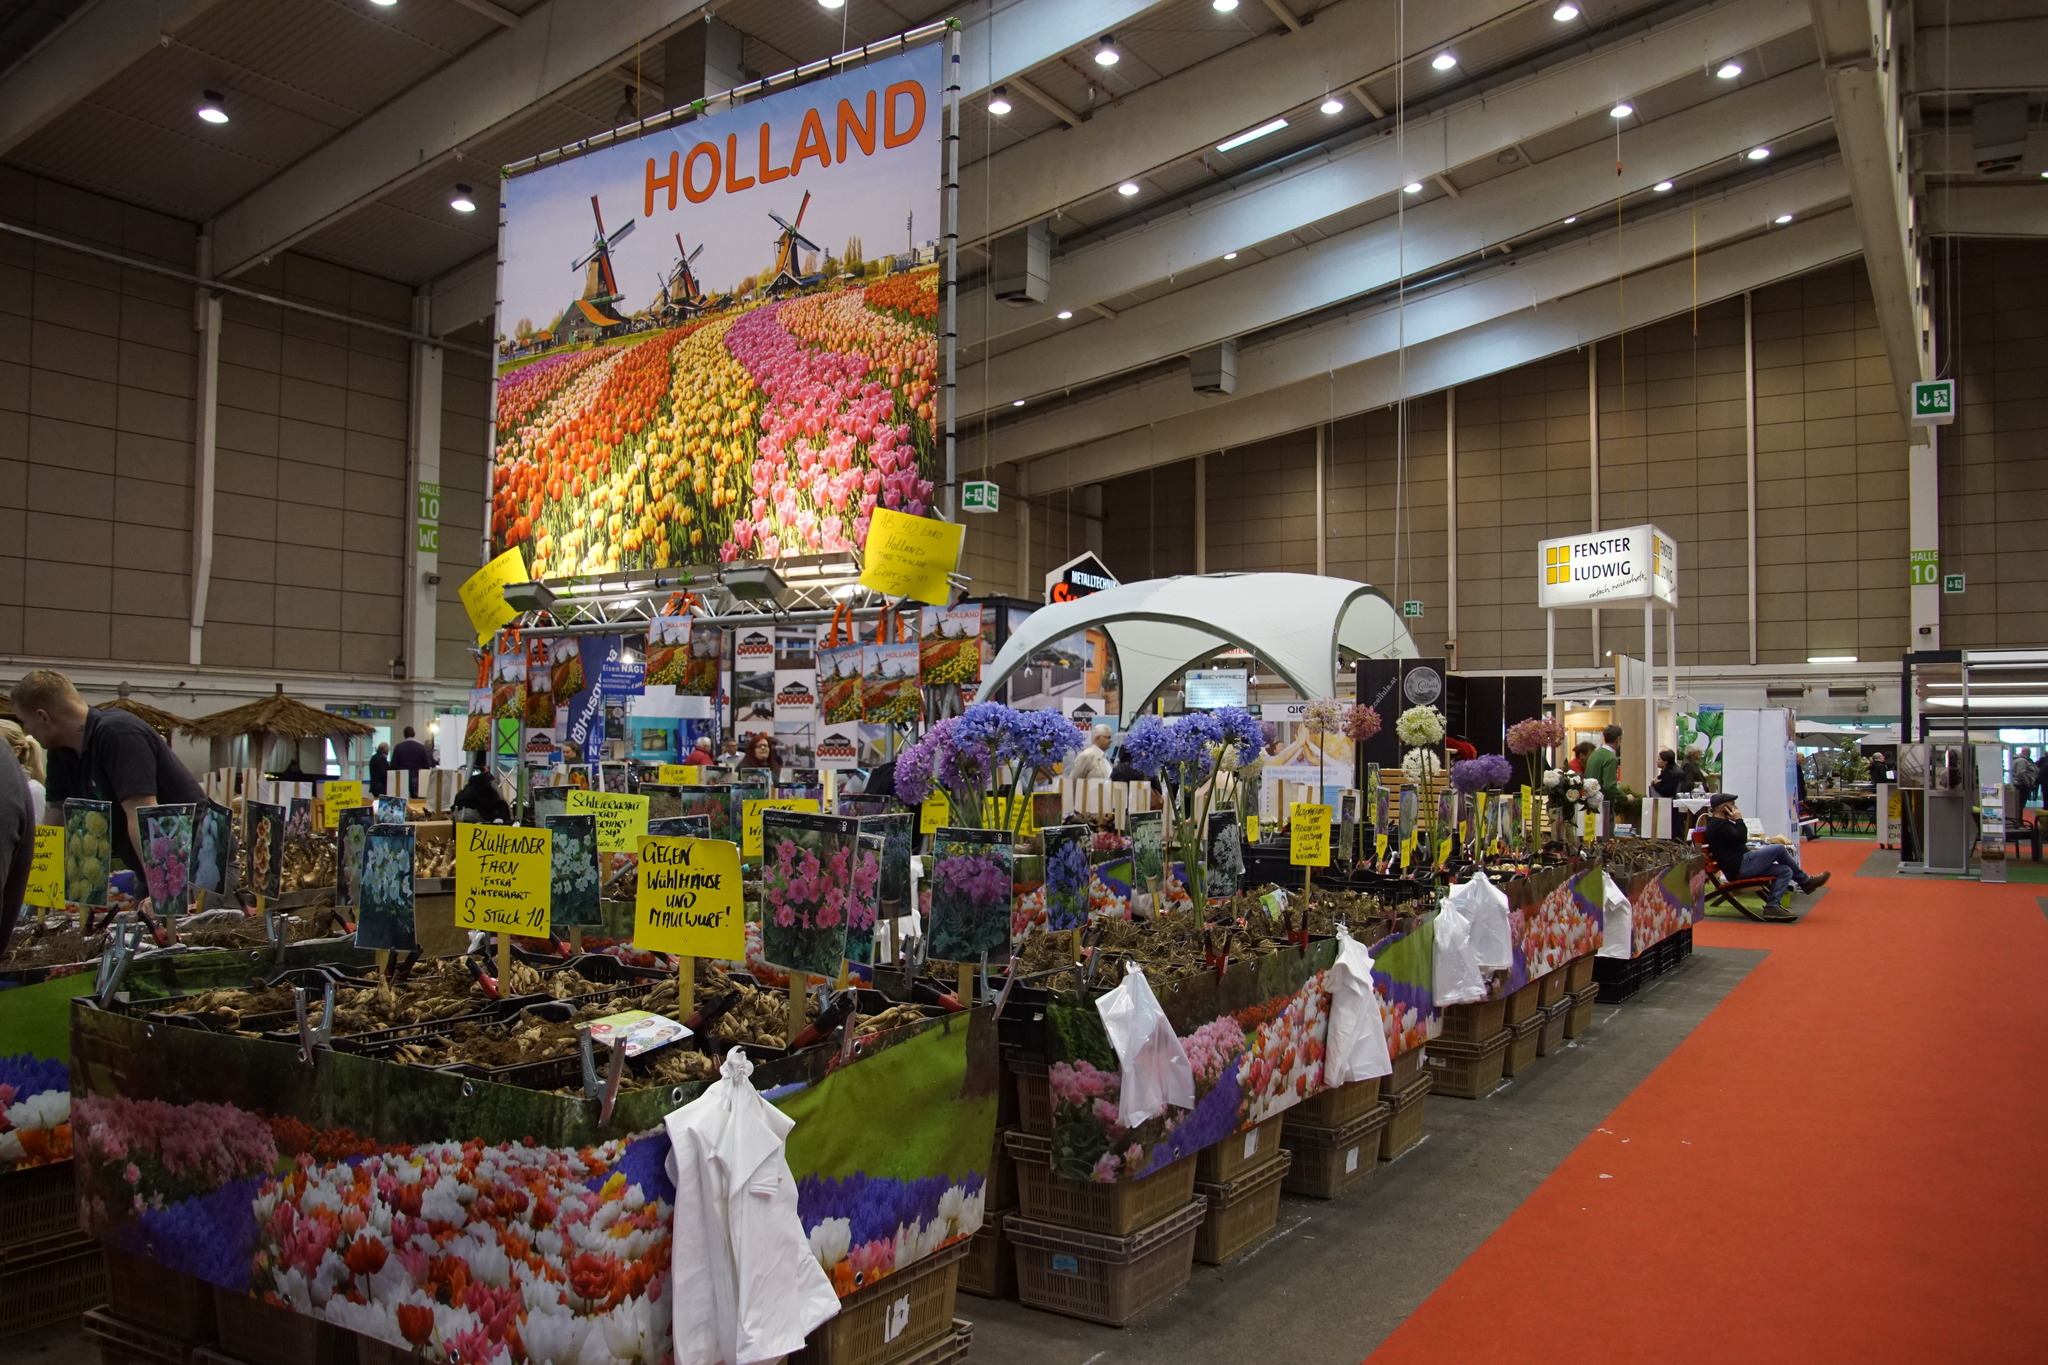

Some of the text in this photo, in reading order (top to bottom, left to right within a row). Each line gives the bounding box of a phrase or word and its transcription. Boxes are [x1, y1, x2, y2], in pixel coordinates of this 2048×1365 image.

[645, 80, 926, 217] HOLLAND
[420, 484, 440, 496] HALLE
[420, 498, 439, 519] 10
[880, 513, 943, 539] AB 40 EURO
[419, 528, 438, 549] WC
[1574, 538, 1630, 558] FENSTER
[1911, 551, 1938, 561] HALLE
[1574, 561, 1630, 581] LUDWIG
[1911, 563, 1938, 584] 10
[946, 611, 980, 619] HOLLAND
[737, 641, 774, 655] Svoboda
[841, 649, 863, 659] HOLLAN
[885, 651, 919, 659] HOLLAND
[621, 664, 645, 674] NAGL
[777, 692, 815, 705] Svoboda
[816, 745, 857, 757] Svoboda
[643, 842, 696, 866] GEGEN
[477, 854, 520, 875] FARN
[470, 886, 532, 901] WINTERHART
[666, 892, 697, 908] UND
[463, 897, 476, 923] 3
[649, 906, 731, 928] MAULWURF!
